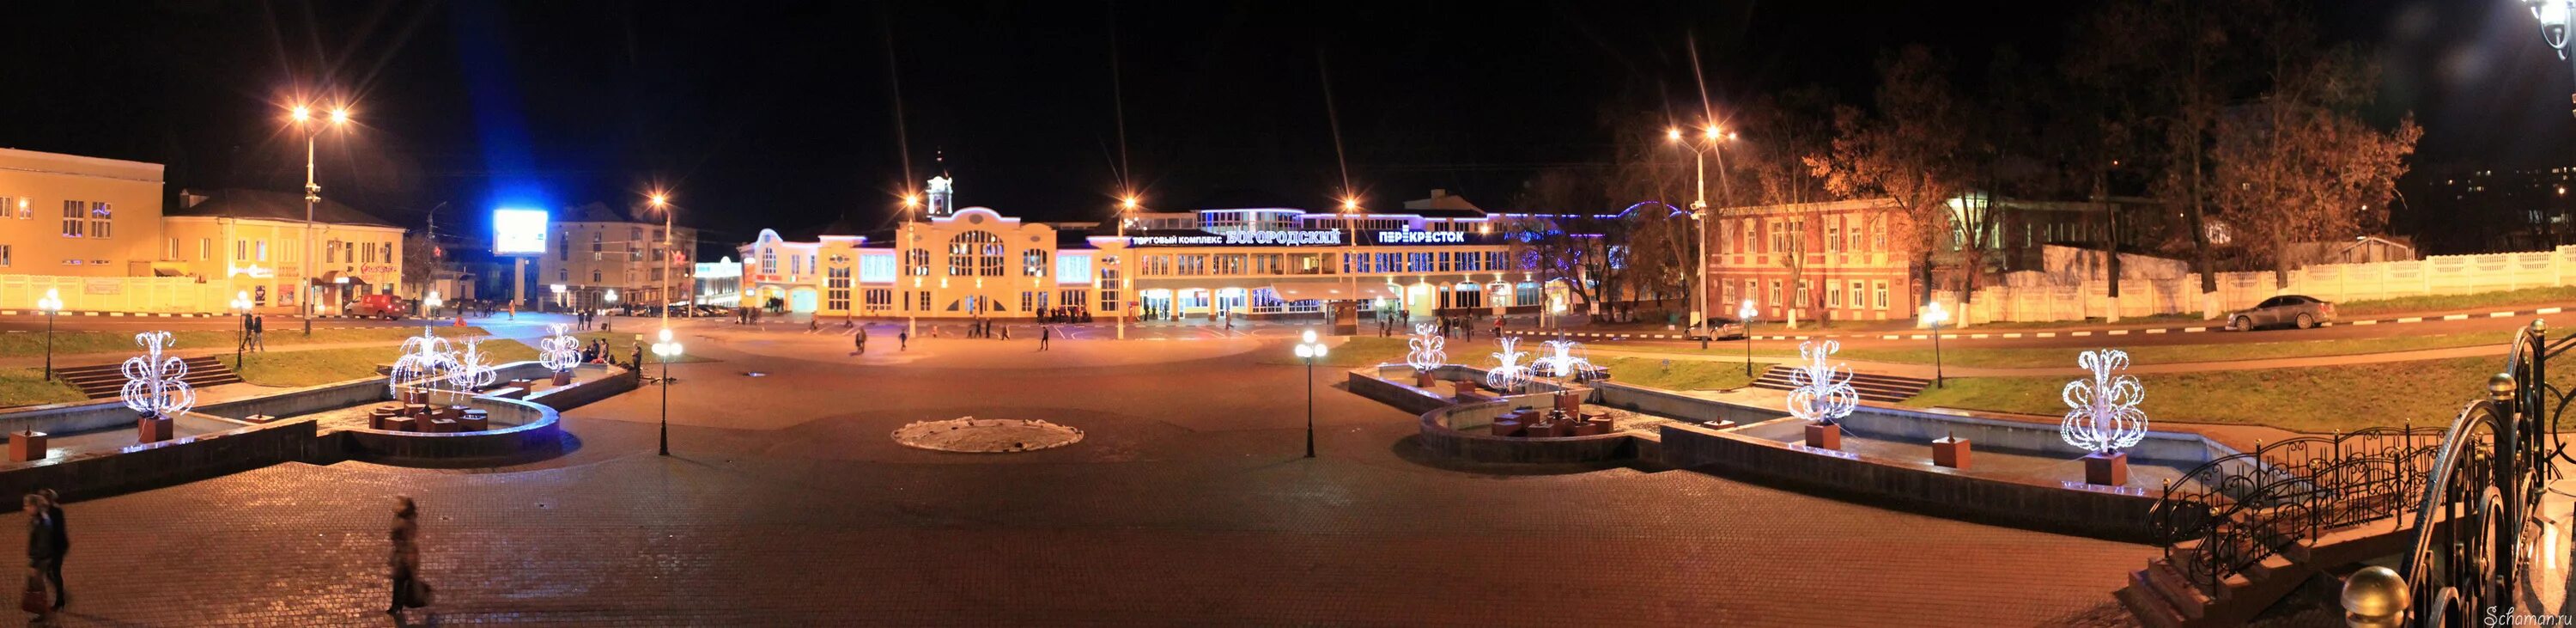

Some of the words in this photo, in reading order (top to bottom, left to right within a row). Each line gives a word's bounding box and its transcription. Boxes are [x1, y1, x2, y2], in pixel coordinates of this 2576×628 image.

[1133, 235, 1177, 245] ТОРГОВЫЙ
[1225, 228, 1340, 247] БОГОРОДСКИЙ
[1379, 224, 1465, 242] ПЕРЕКРЕСТОК
